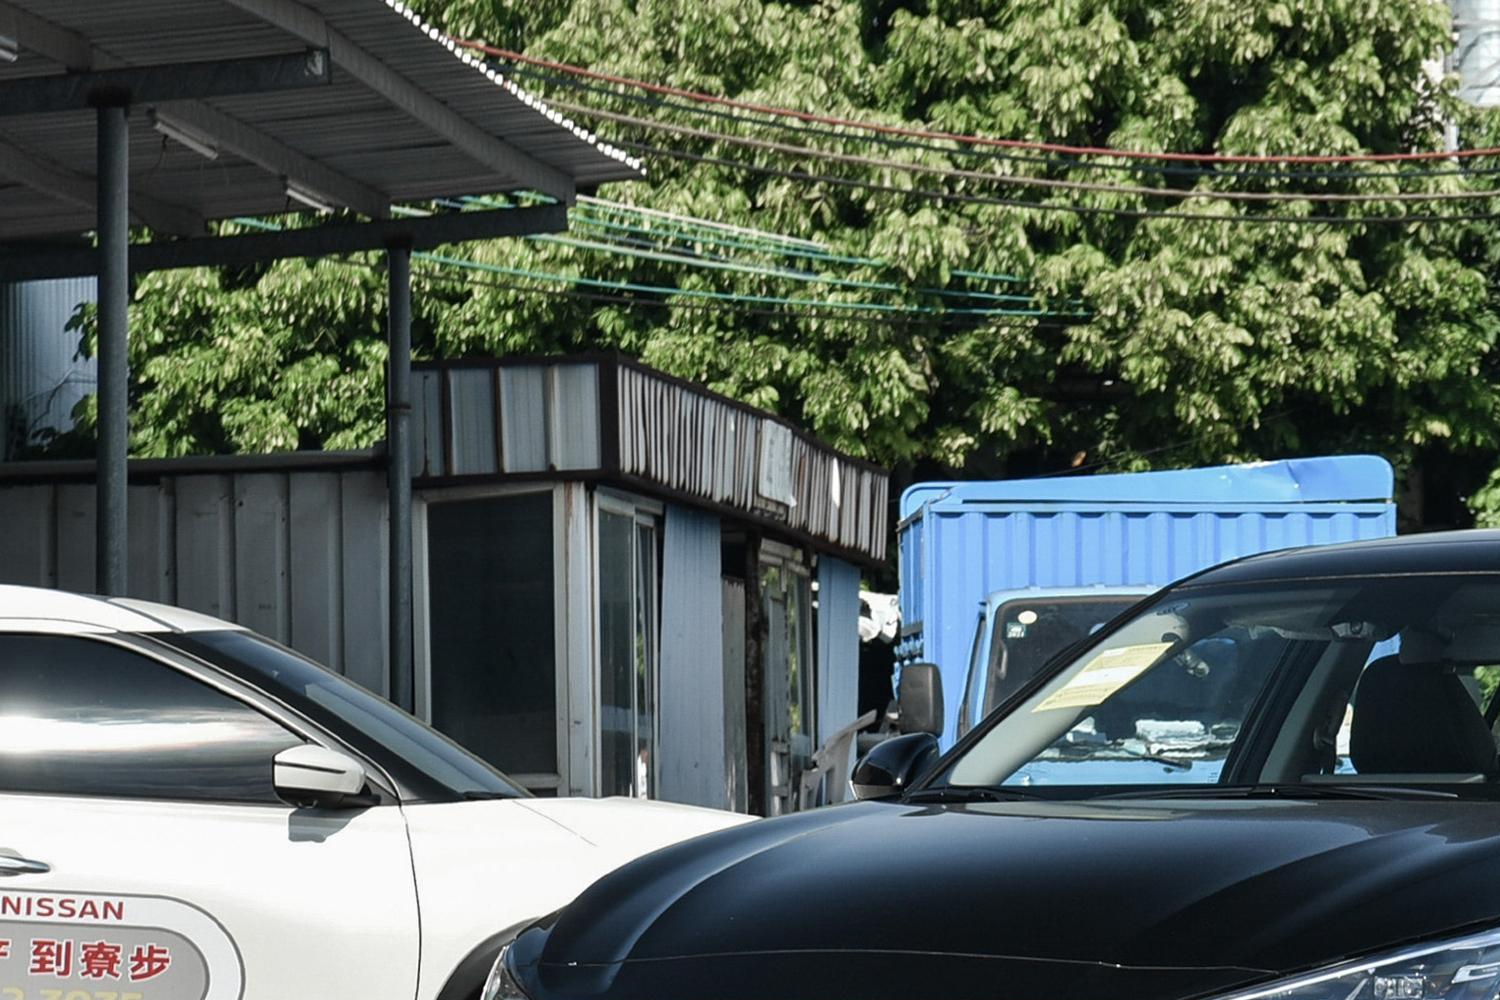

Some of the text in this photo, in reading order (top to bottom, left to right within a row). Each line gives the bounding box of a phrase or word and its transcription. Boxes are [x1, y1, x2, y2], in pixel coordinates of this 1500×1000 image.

[1, 895, 124, 921] NISSAN
[29, 939, 171, 981] 到寮步
